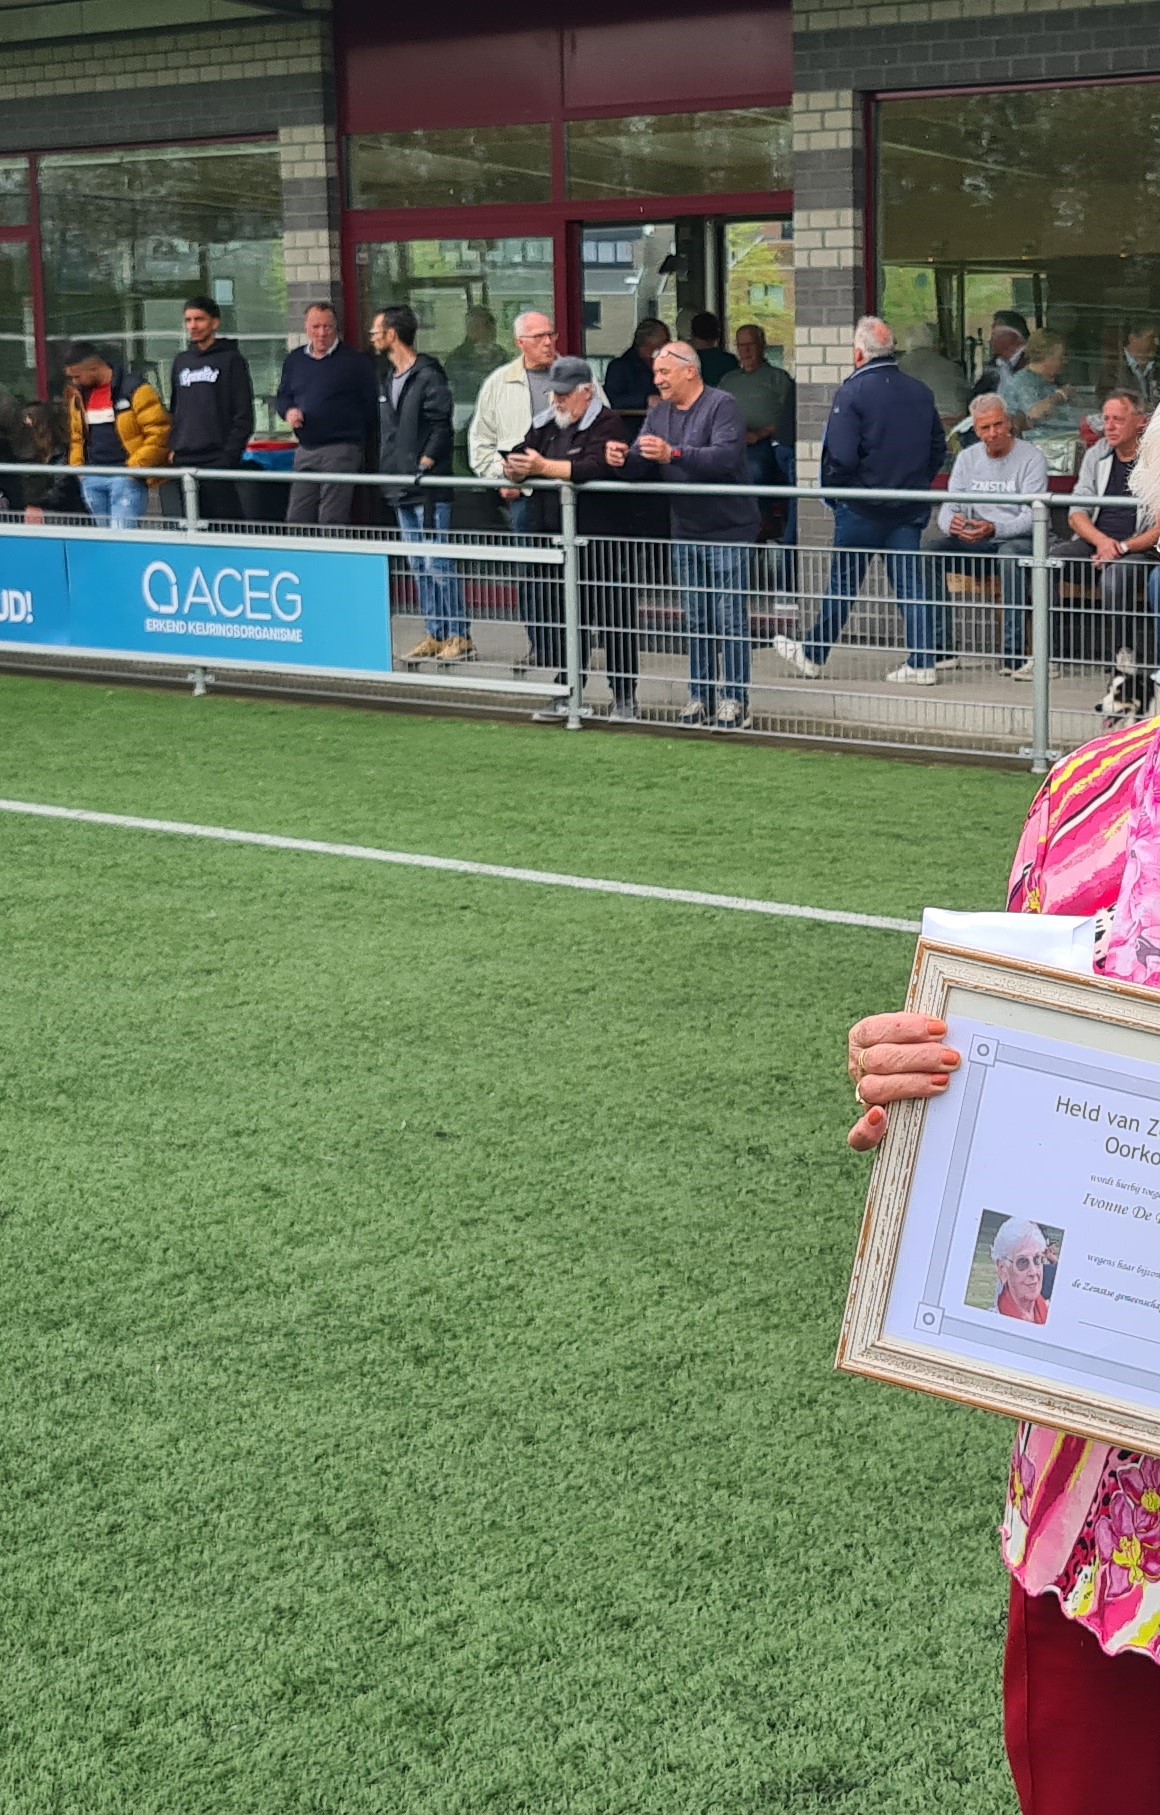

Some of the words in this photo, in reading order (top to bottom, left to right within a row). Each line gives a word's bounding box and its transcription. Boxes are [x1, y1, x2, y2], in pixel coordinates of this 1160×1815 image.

[182, 566, 303, 622] ACEG
[145, 618, 187, 635] ERKEND
[187, 621, 304, 643] KEURINGSORGANISME
[1055, 1095, 1101, 1122] Held
[1107, 1111, 1140, 1132] van
[1090, 1174, 1114, 1186] wordt
[1115, 1178, 1141, 1195] hierbij
[1082, 1193, 1129, 1215] Ivonne
[1132, 1205, 1152, 1221] De
[1117, 1259, 1136, 1272] haar
[1071, 1279, 1081, 1289] de
